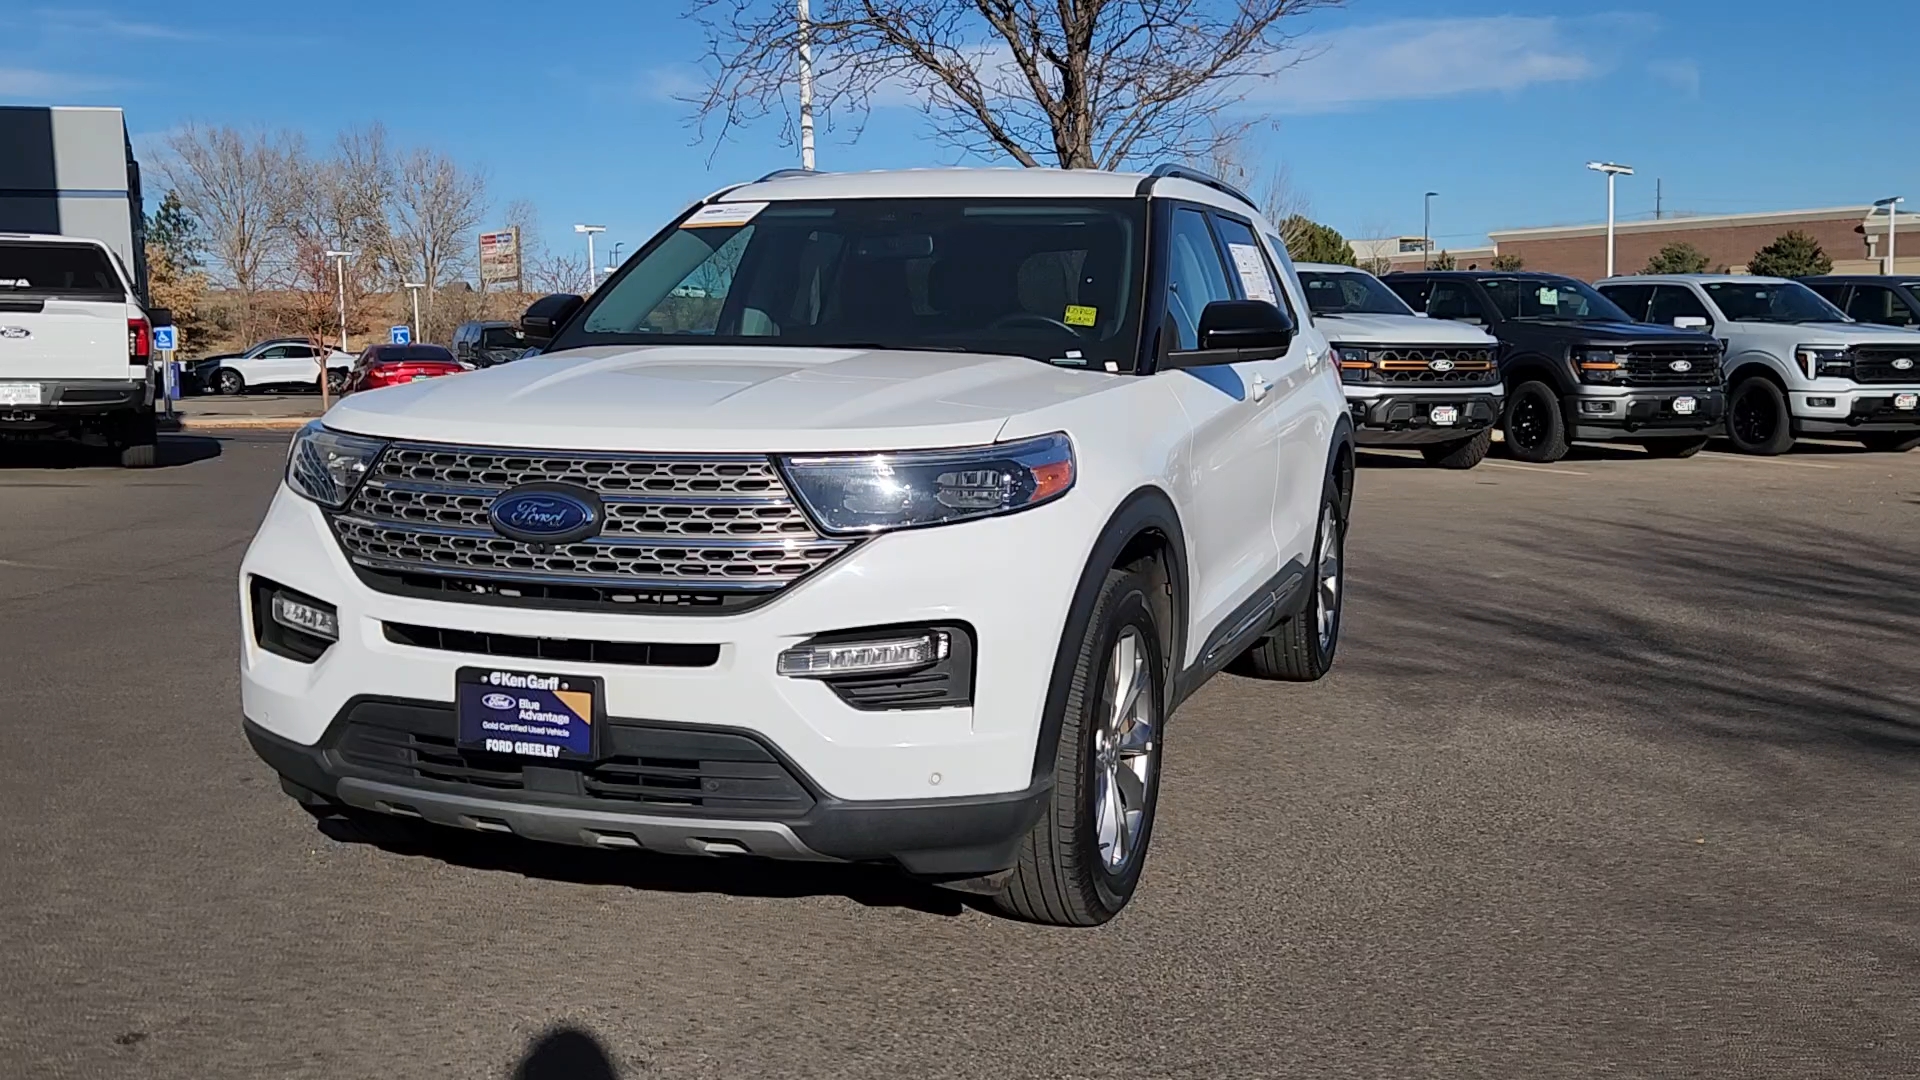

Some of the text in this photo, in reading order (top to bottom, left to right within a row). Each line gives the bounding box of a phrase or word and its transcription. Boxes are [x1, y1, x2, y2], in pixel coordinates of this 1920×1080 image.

[3, 326, 27, 338] Ford
[1673, 398, 1696, 412] Garff
[1430, 408, 1458, 422] Garff
[511, 500, 567, 526] Ford
[501, 672, 560, 690] Ken Garff
[488, 695, 510, 707] Ford
[518, 698, 540, 710] Blue
[518, 709, 570, 725] Advantage
[482, 720, 570, 738] Gold Certified Used Vehicle
[486, 738, 560, 758] FORD GREELEY
